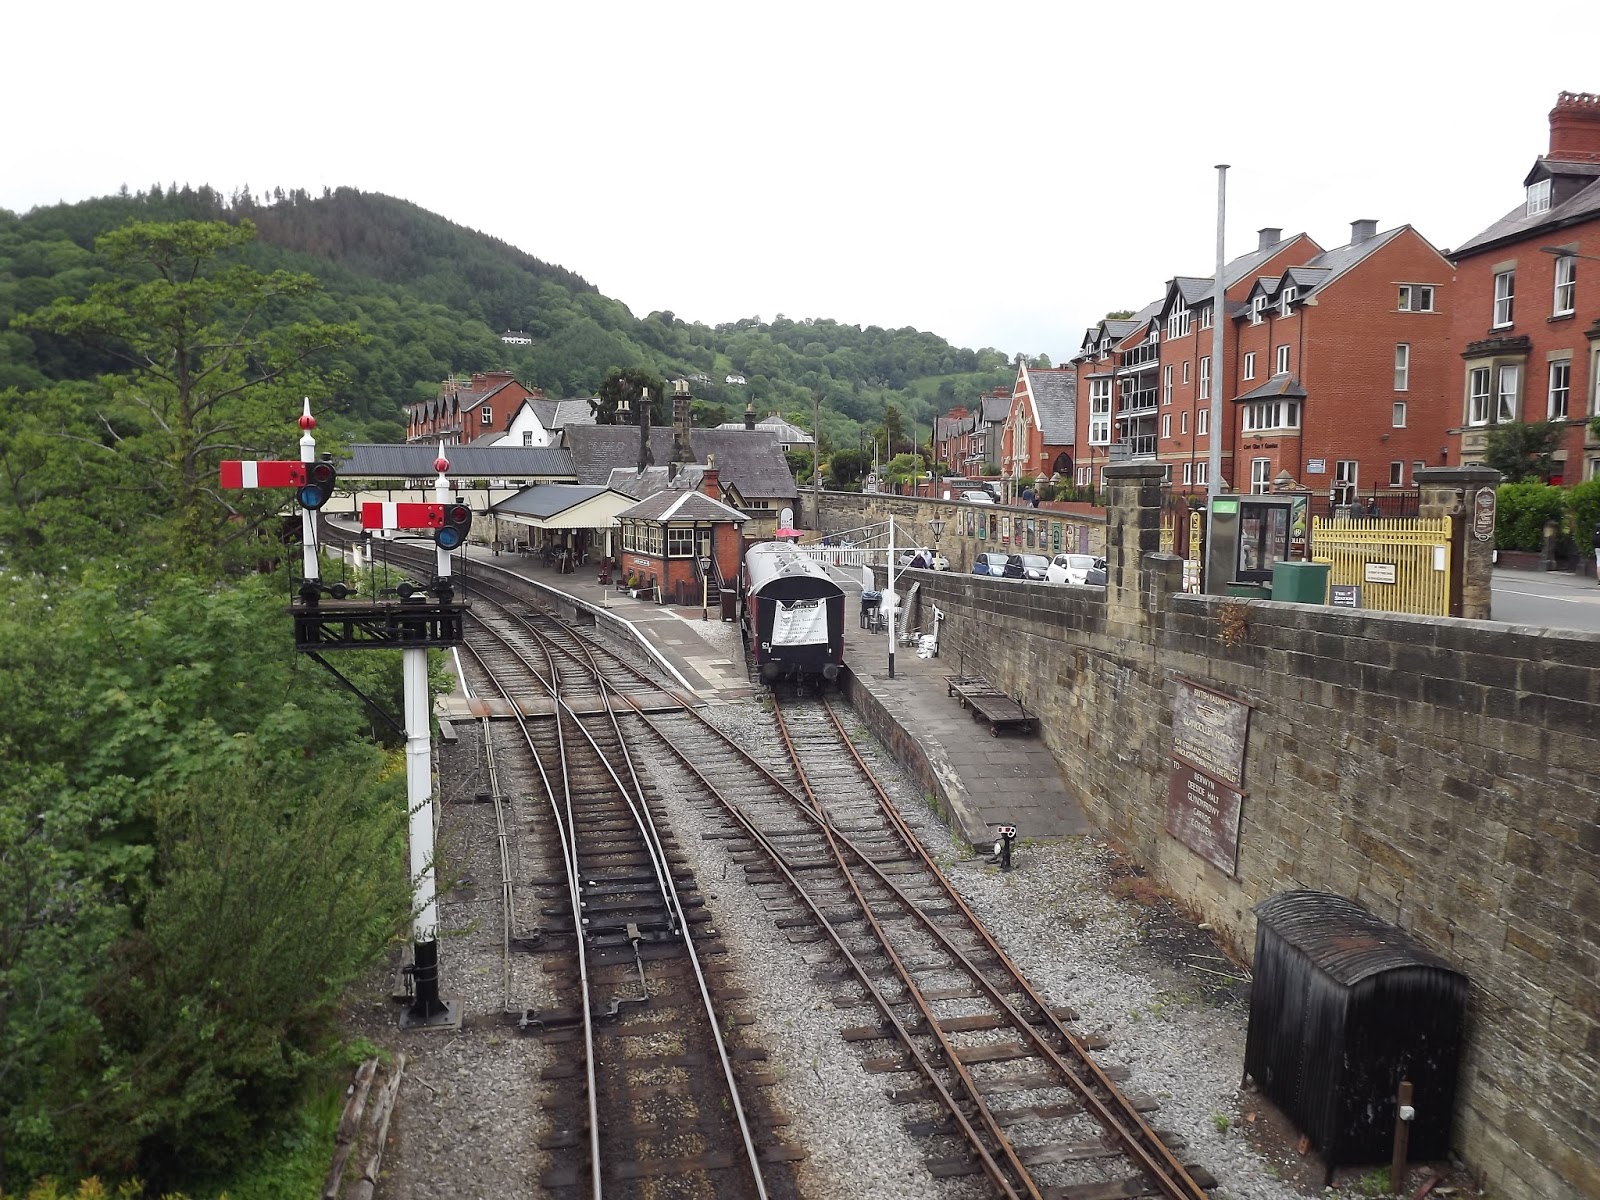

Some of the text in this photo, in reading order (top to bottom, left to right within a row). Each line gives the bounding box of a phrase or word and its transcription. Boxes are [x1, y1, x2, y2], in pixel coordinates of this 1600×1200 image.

[1183, 716, 1214, 737] LLANGOLLEN
[1214, 730, 1235, 748] STATION
[1193, 772, 1215, 790] BERWYN
[1187, 780, 1219, 804] DEESIDE HALT
[1192, 807, 1212, 825] CARROG
